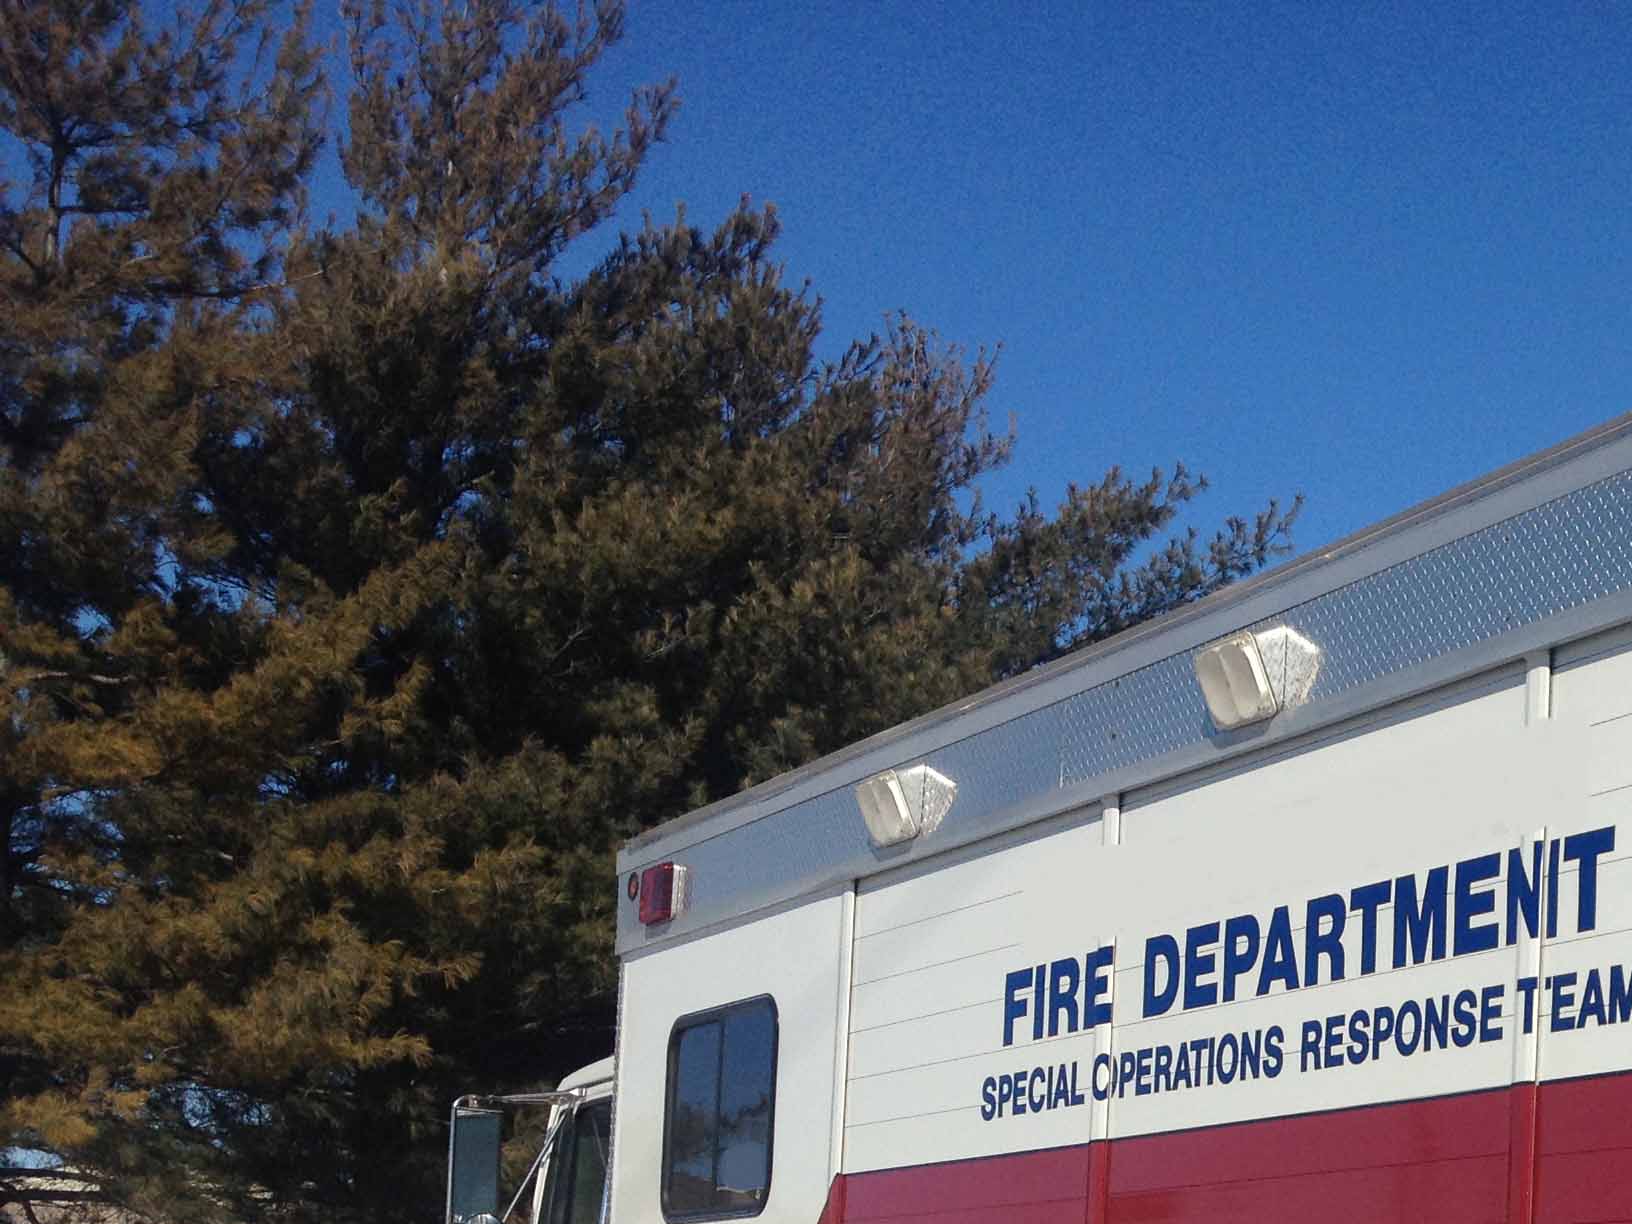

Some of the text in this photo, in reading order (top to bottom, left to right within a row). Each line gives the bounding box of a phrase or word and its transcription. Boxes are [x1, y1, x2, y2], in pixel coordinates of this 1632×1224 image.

[1002, 825, 1616, 1047] FIRE DEPARTMENT
[980, 1061, 1085, 1121] SPECIAL
[1091, 1026, 1284, 1101] OPERATIONS
[1300, 985, 1504, 1072] RESPONSE
